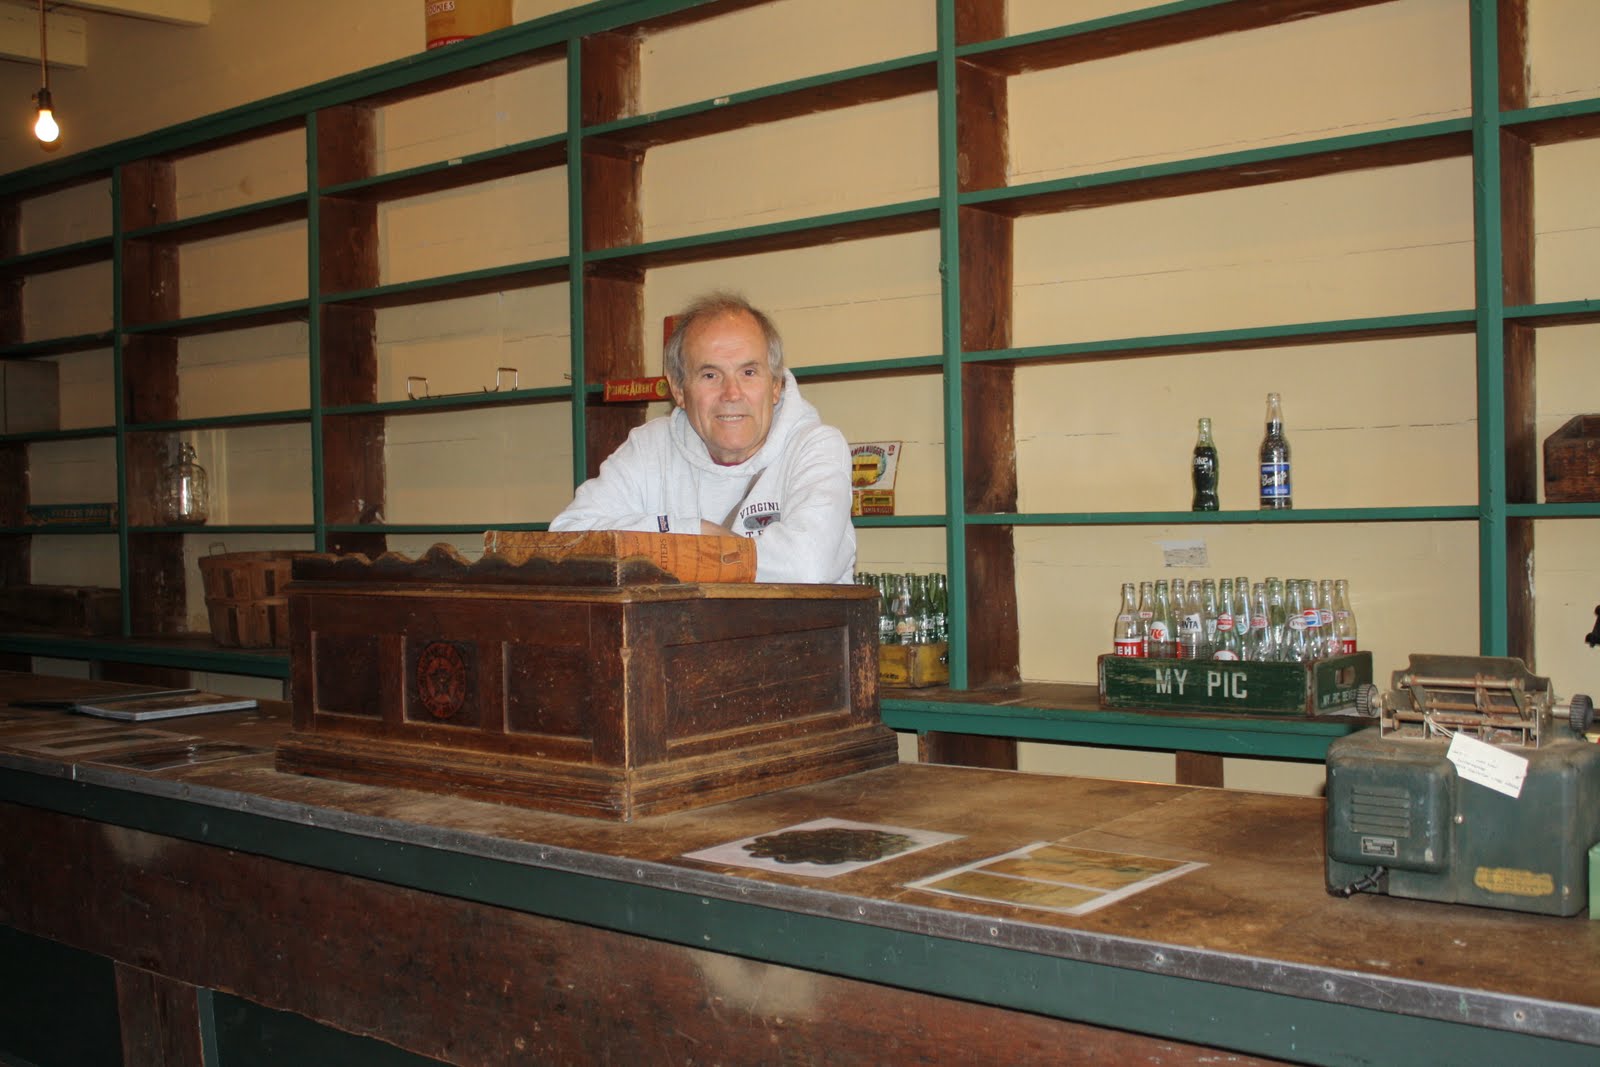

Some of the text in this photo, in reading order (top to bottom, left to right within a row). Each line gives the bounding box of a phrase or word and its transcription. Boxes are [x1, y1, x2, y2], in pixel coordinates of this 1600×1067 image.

[740, 502, 780, 519] VIRGINI
[660, 538, 668, 570] ETTERS
[1117, 645, 1138, 655] EHI
[1155, 668, 1248, 698] MY PIC
